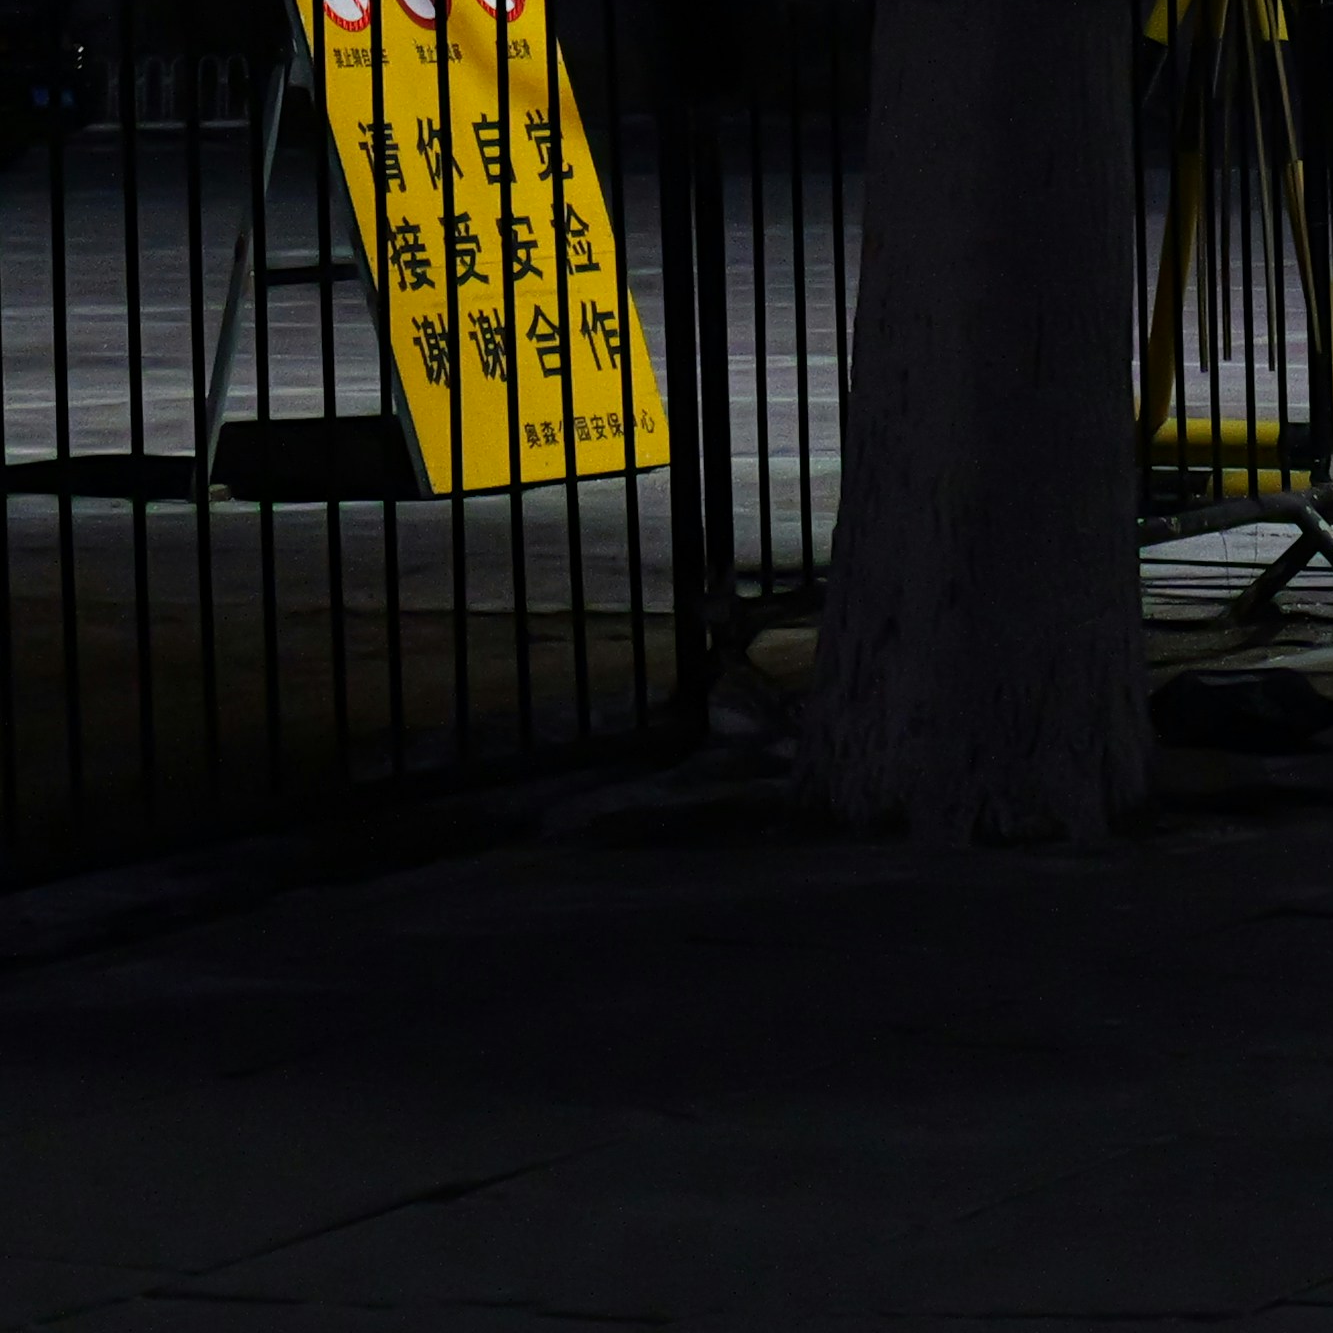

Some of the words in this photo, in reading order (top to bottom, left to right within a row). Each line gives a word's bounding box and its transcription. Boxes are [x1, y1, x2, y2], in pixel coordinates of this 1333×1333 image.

[333, 47, 390, 69] 禁止骑自车
[411, 299, 622, 389] 谢谢合作
[524, 408, 655, 449] 奥森园安保心
